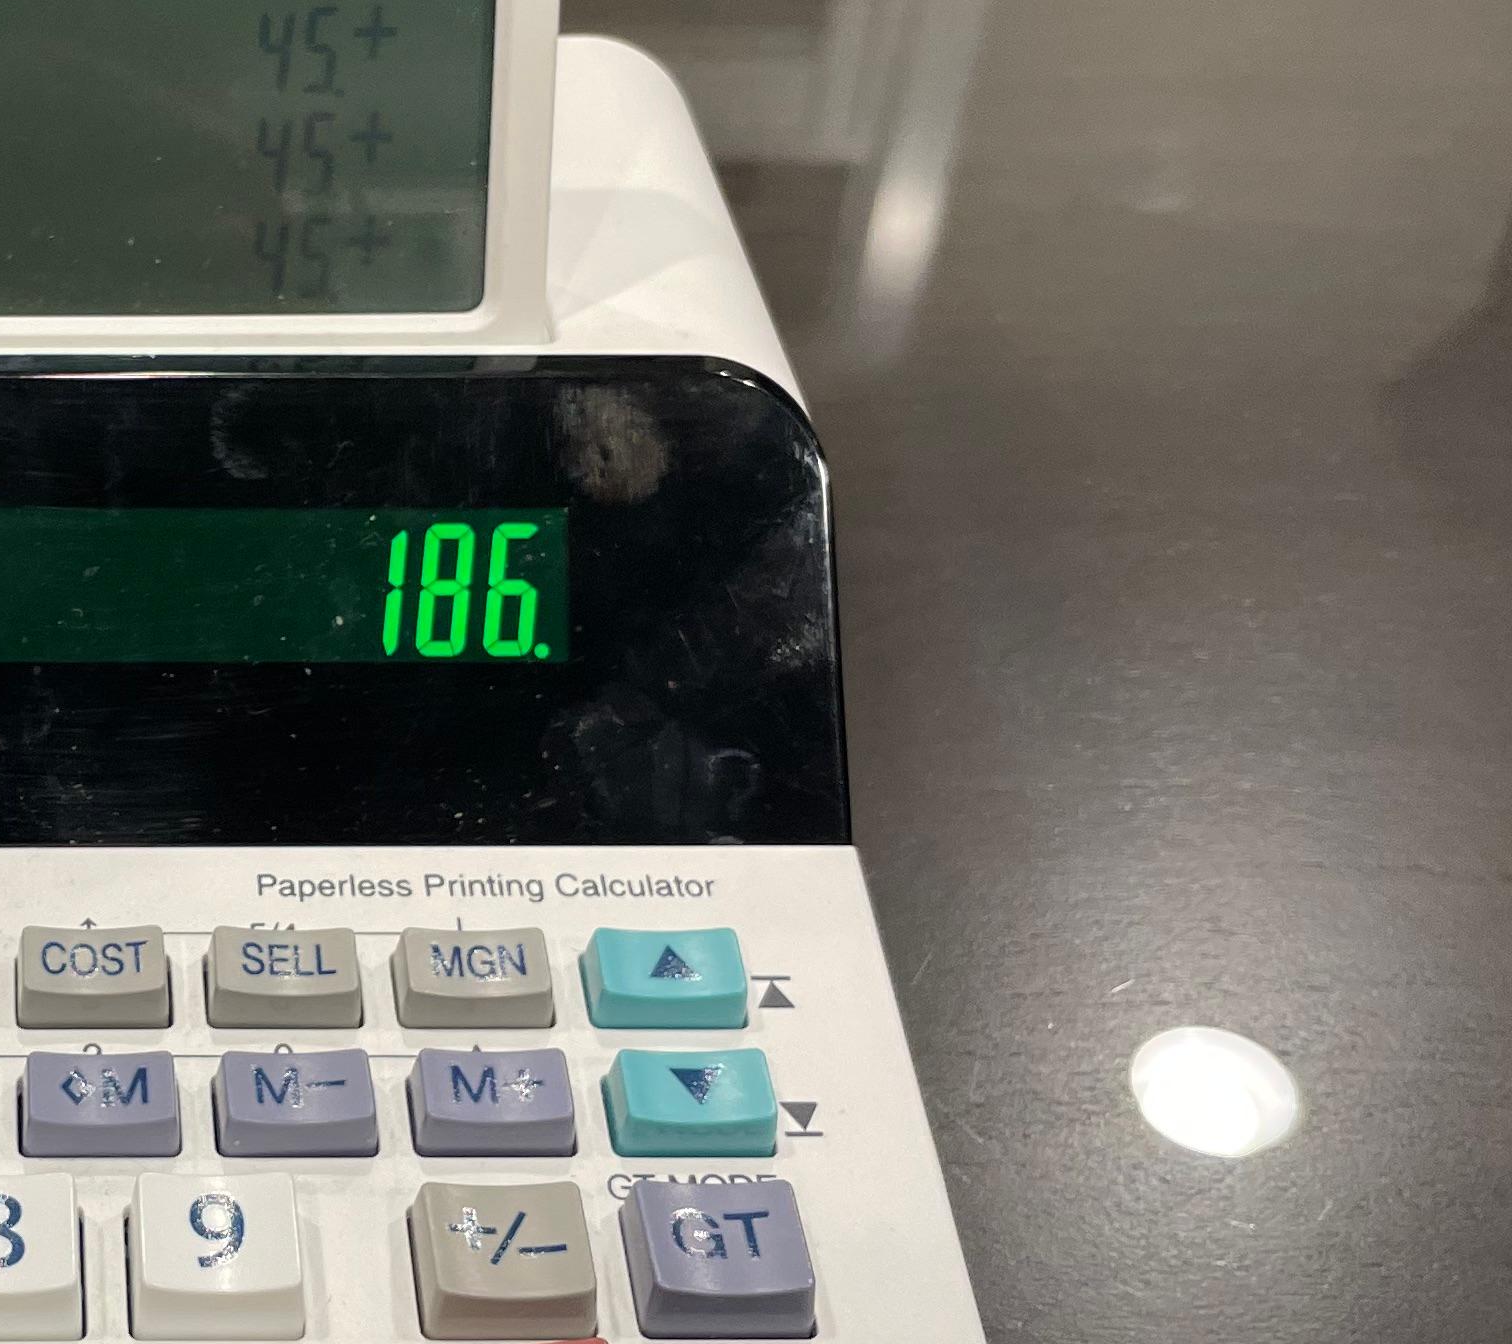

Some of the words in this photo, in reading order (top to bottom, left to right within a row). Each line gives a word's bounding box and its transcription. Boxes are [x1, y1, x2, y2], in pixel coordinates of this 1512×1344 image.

[256, 872, 413, 902] Paperless
[423, 872, 545, 903] Printing
[554, 872, 715, 898] Calculator
[42, 940, 149, 976] COST
[242, 941, 337, 977] SELL
[431, 943, 527, 978] MGN
[188, 1192, 245, 1269] 9
[671, 1207, 769, 1260] GT
